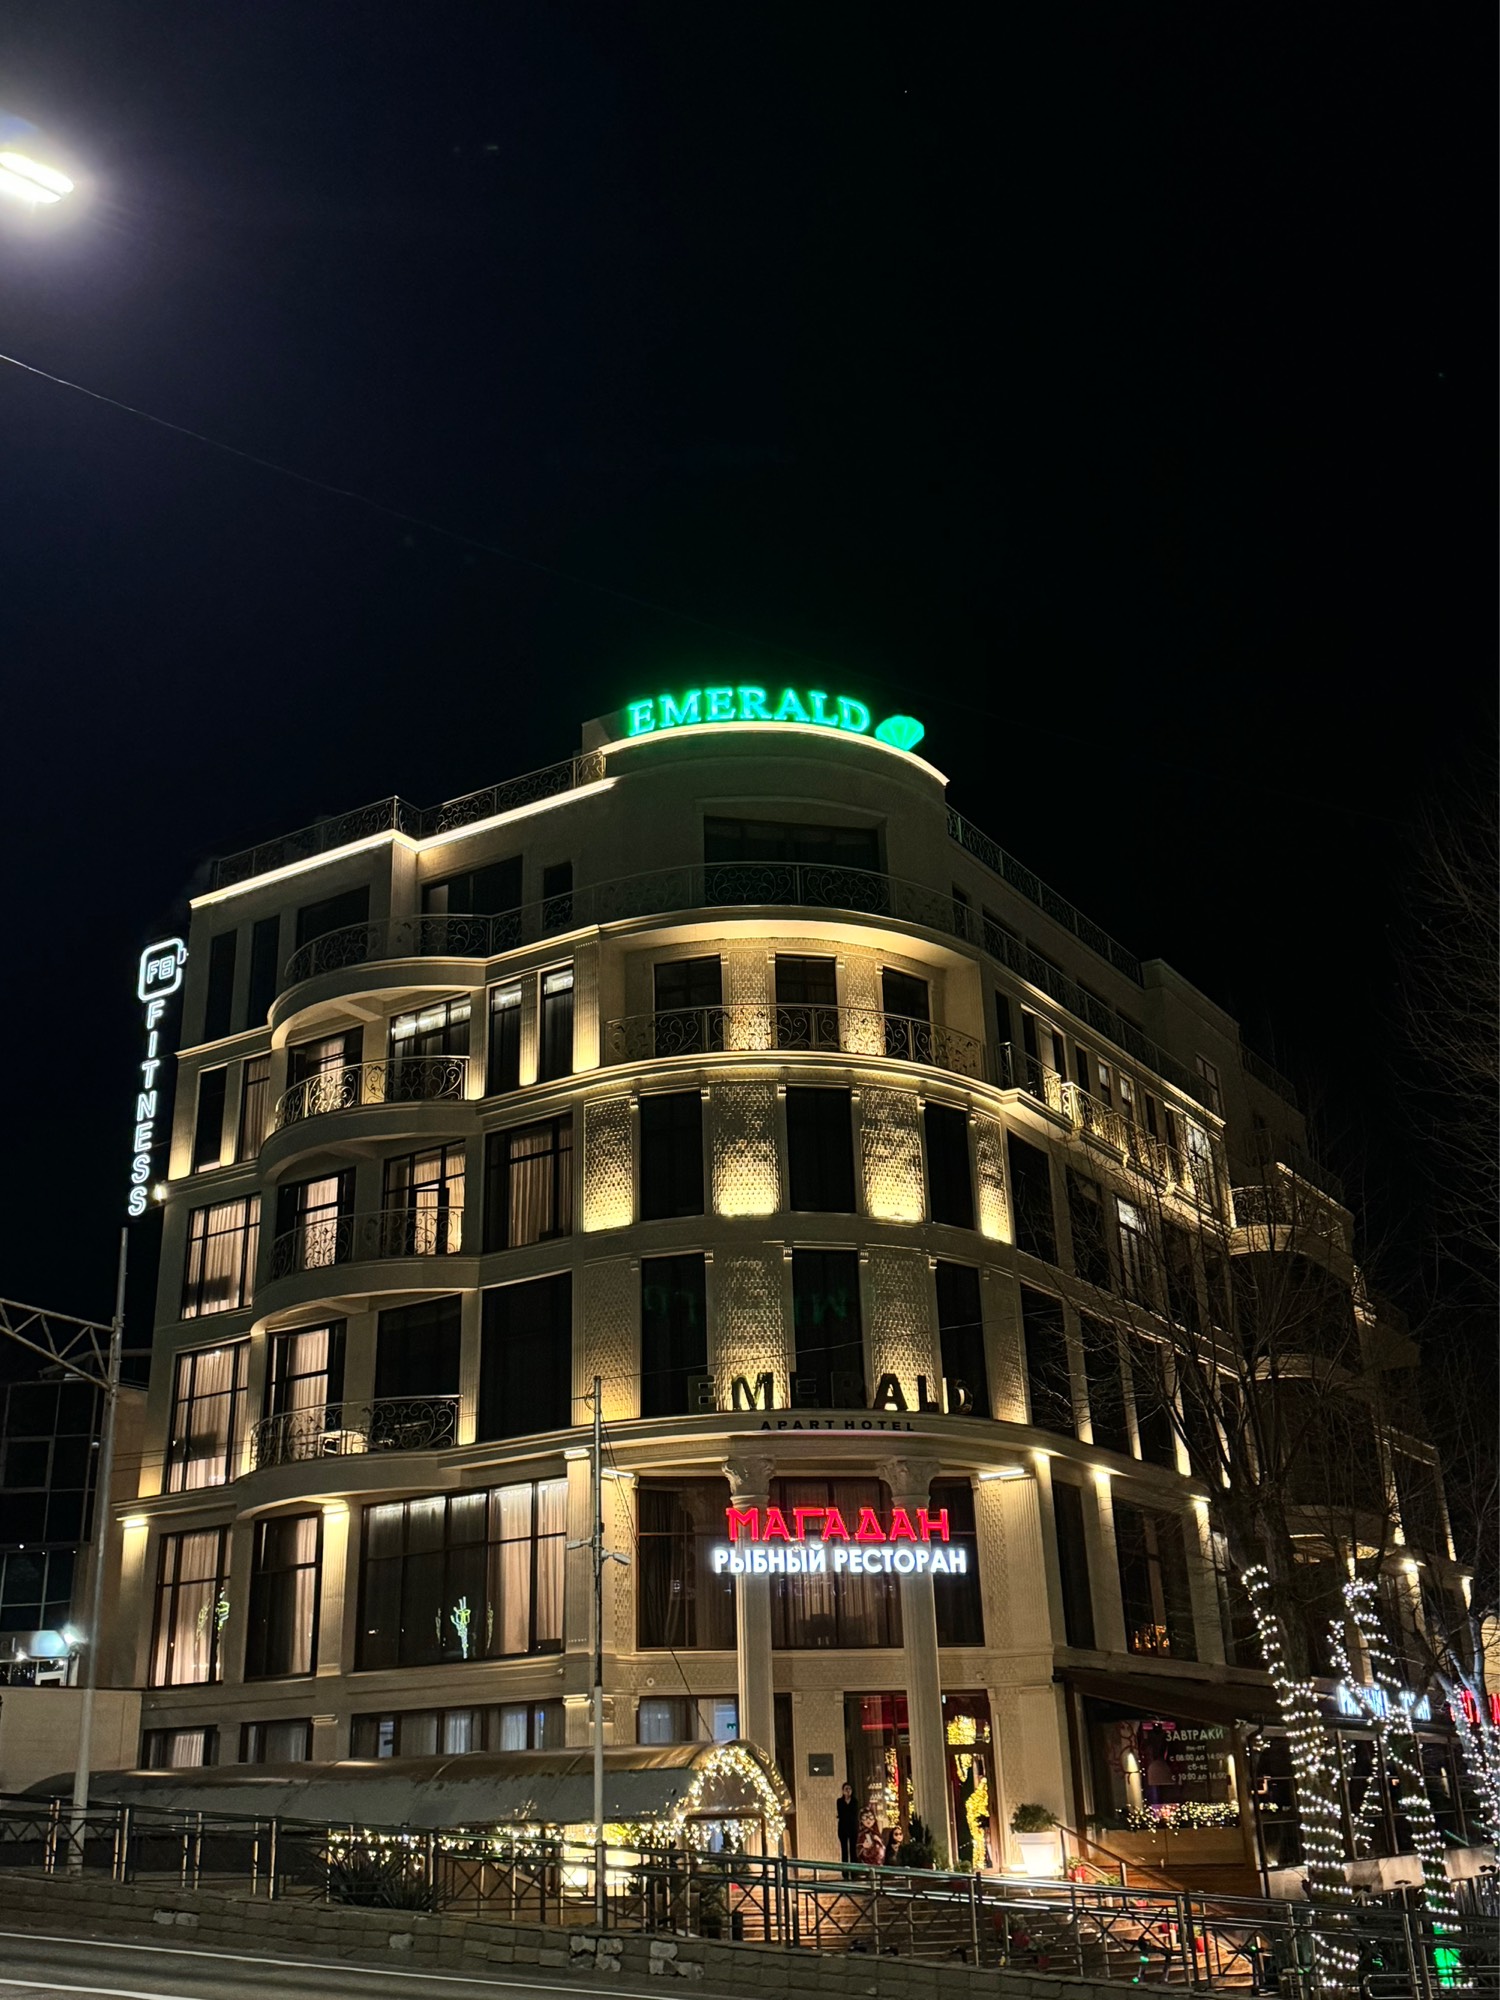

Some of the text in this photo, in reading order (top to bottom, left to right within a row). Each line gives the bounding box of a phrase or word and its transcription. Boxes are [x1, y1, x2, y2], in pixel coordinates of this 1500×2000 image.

[627, 686, 871, 737] EMERALD
[128, 999, 166, 1217] FITNESS
[761, 1419, 915, 1431] APART HOTEL
[725, 1506, 950, 1542] МАГАДАН
[714, 1544, 968, 1574] РЫБНЫЙ РЕСТОРАН
[1166, 1729, 1224, 1741] ЗАВТРАКИ
